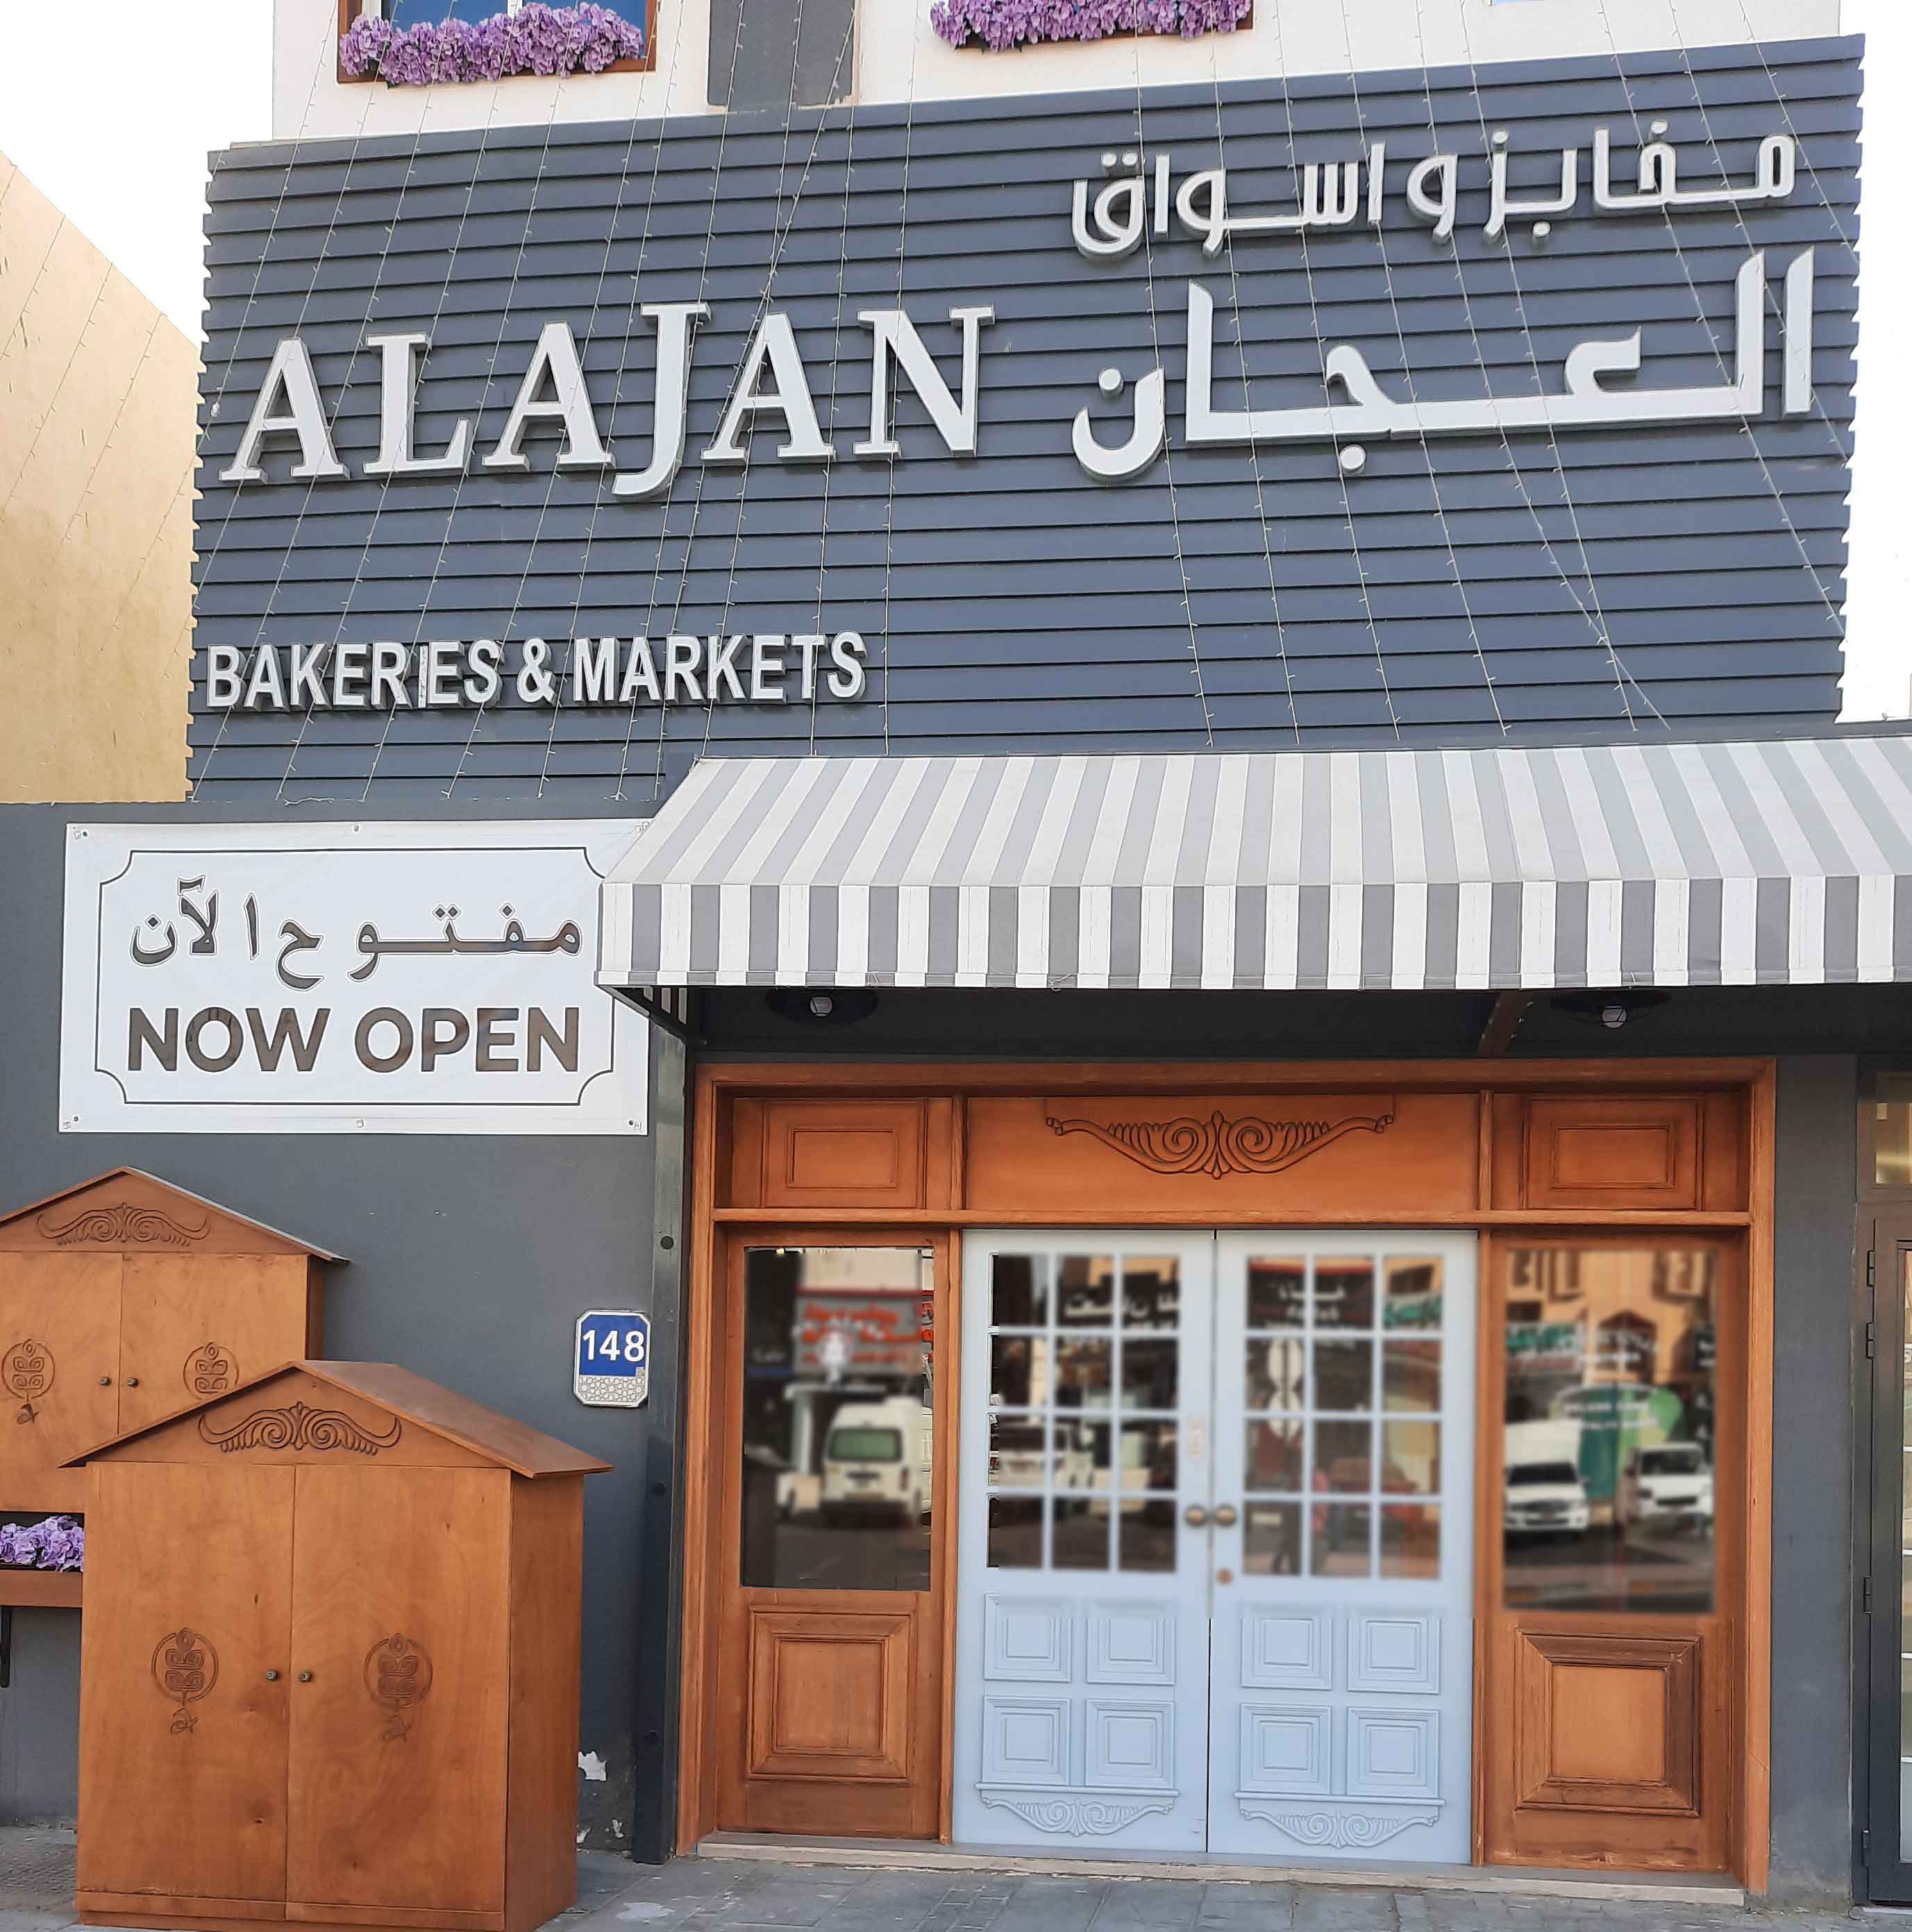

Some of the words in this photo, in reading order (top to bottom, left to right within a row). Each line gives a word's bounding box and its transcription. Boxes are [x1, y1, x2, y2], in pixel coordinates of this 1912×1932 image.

[219, 302, 995, 501] ALAJAN
[1072, 244, 1814, 481] العجان
[206, 637, 503, 710] BAKERIES
[517, 637, 557, 706] &
[573, 630, 869, 706] MARKETS
[277, 905, 582, 991] مفتوح
[128, 1007, 330, 1073] NOW
[354, 1007, 580, 1073] OPEN
[583, 1330, 644, 1362] 148
